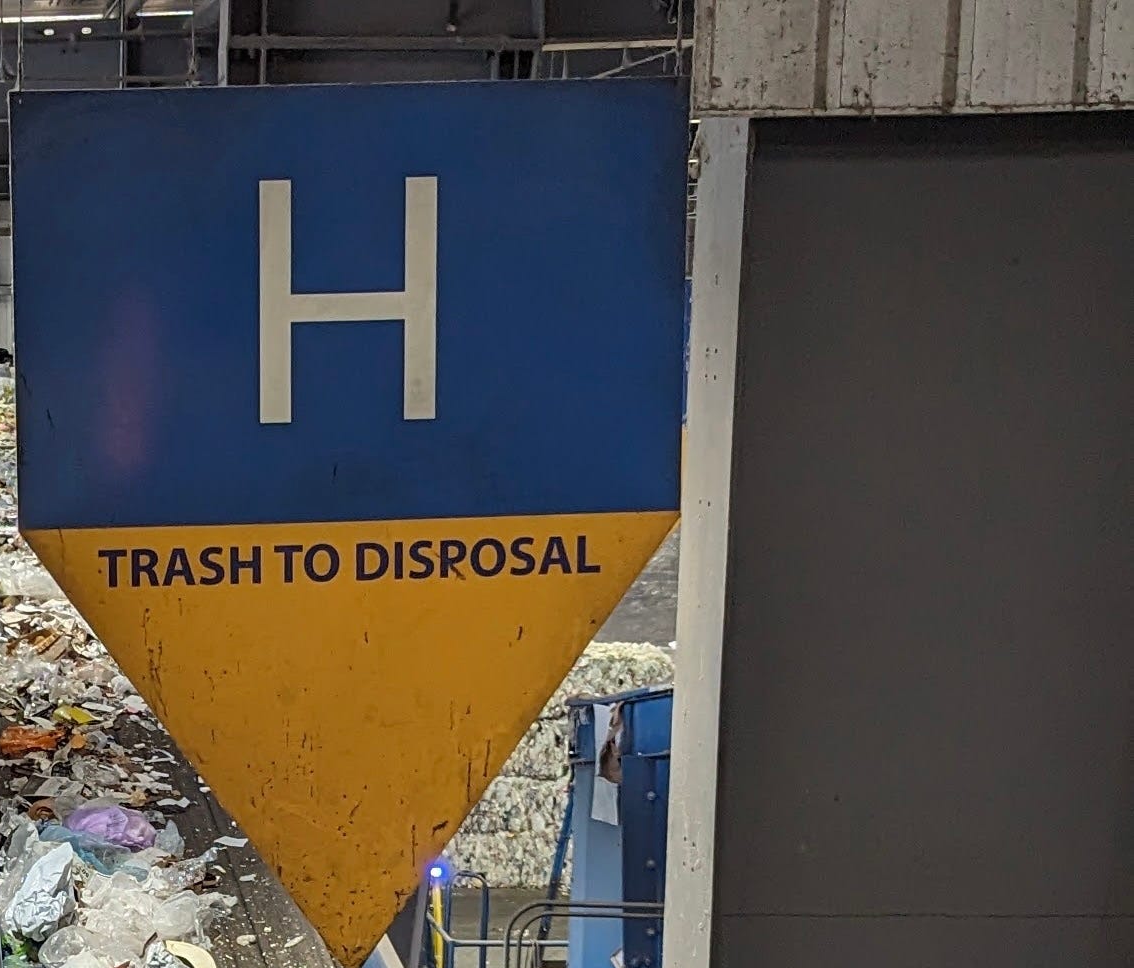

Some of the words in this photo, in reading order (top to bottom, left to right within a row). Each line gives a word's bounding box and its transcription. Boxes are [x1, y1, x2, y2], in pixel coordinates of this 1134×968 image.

[259, 176, 437, 423] H
[98, 546, 262, 588] TRASH
[274, 543, 340, 583] TO
